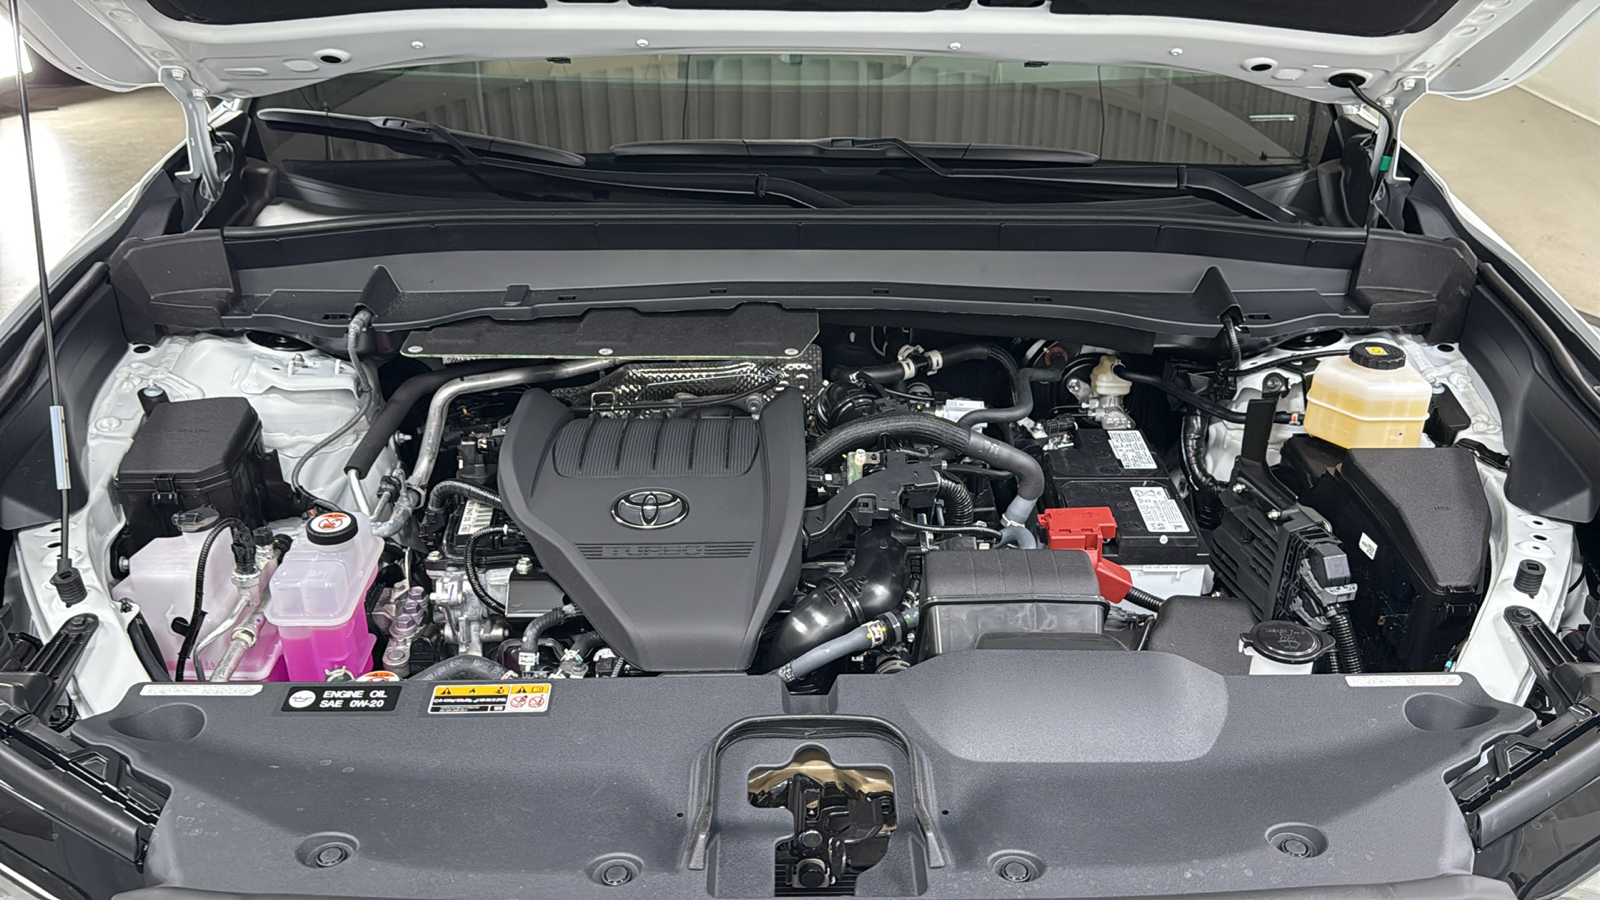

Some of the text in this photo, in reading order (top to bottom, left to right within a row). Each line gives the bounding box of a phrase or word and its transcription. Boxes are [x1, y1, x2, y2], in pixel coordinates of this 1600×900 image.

[605, 545, 702, 556] TURBO
[323, 690, 387, 698] ENGINE OIL
[319, 699, 384, 708] SAE 0W-20
